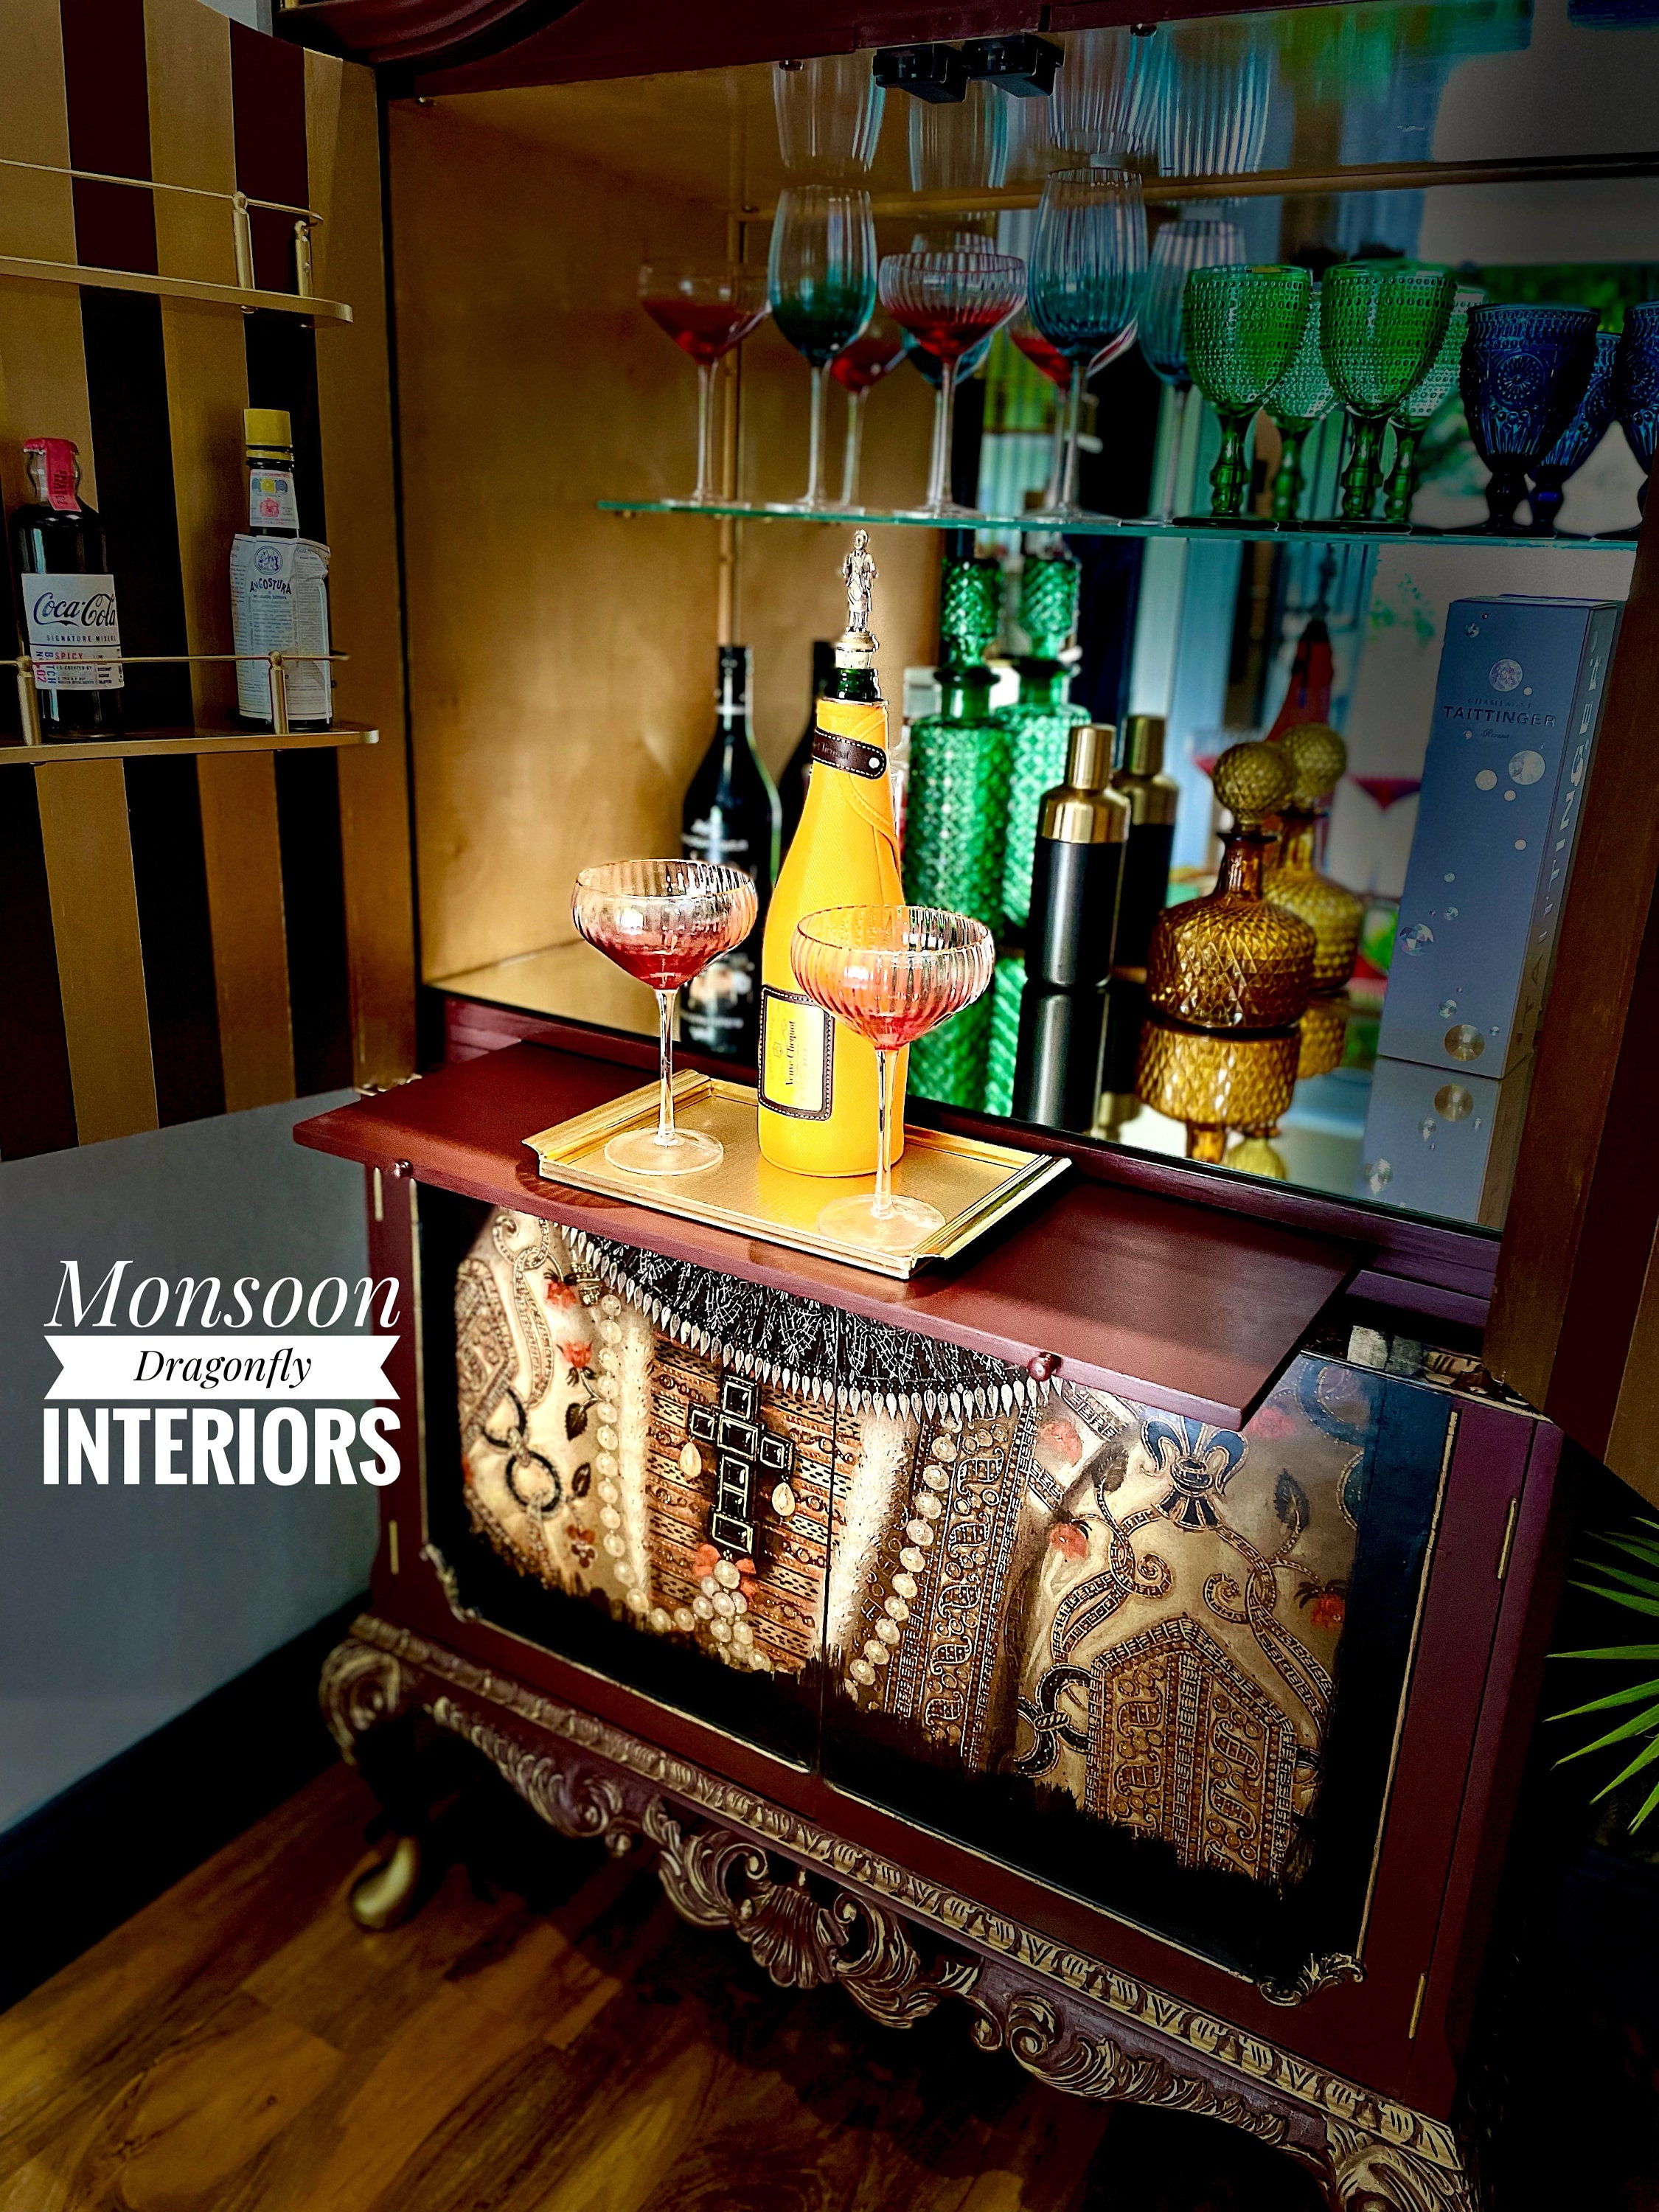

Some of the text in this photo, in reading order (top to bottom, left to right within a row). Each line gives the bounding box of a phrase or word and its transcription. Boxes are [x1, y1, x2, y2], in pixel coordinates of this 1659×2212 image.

[250, 578, 291, 594] ANGOSTURA
[33, 592, 116, 626] Coca-Cola
[45, 652, 57, 684] BTCH
[1443, 706, 1557, 728] TAITTINGER
[785, 1020, 797, 1085] Veuve Clicquot
